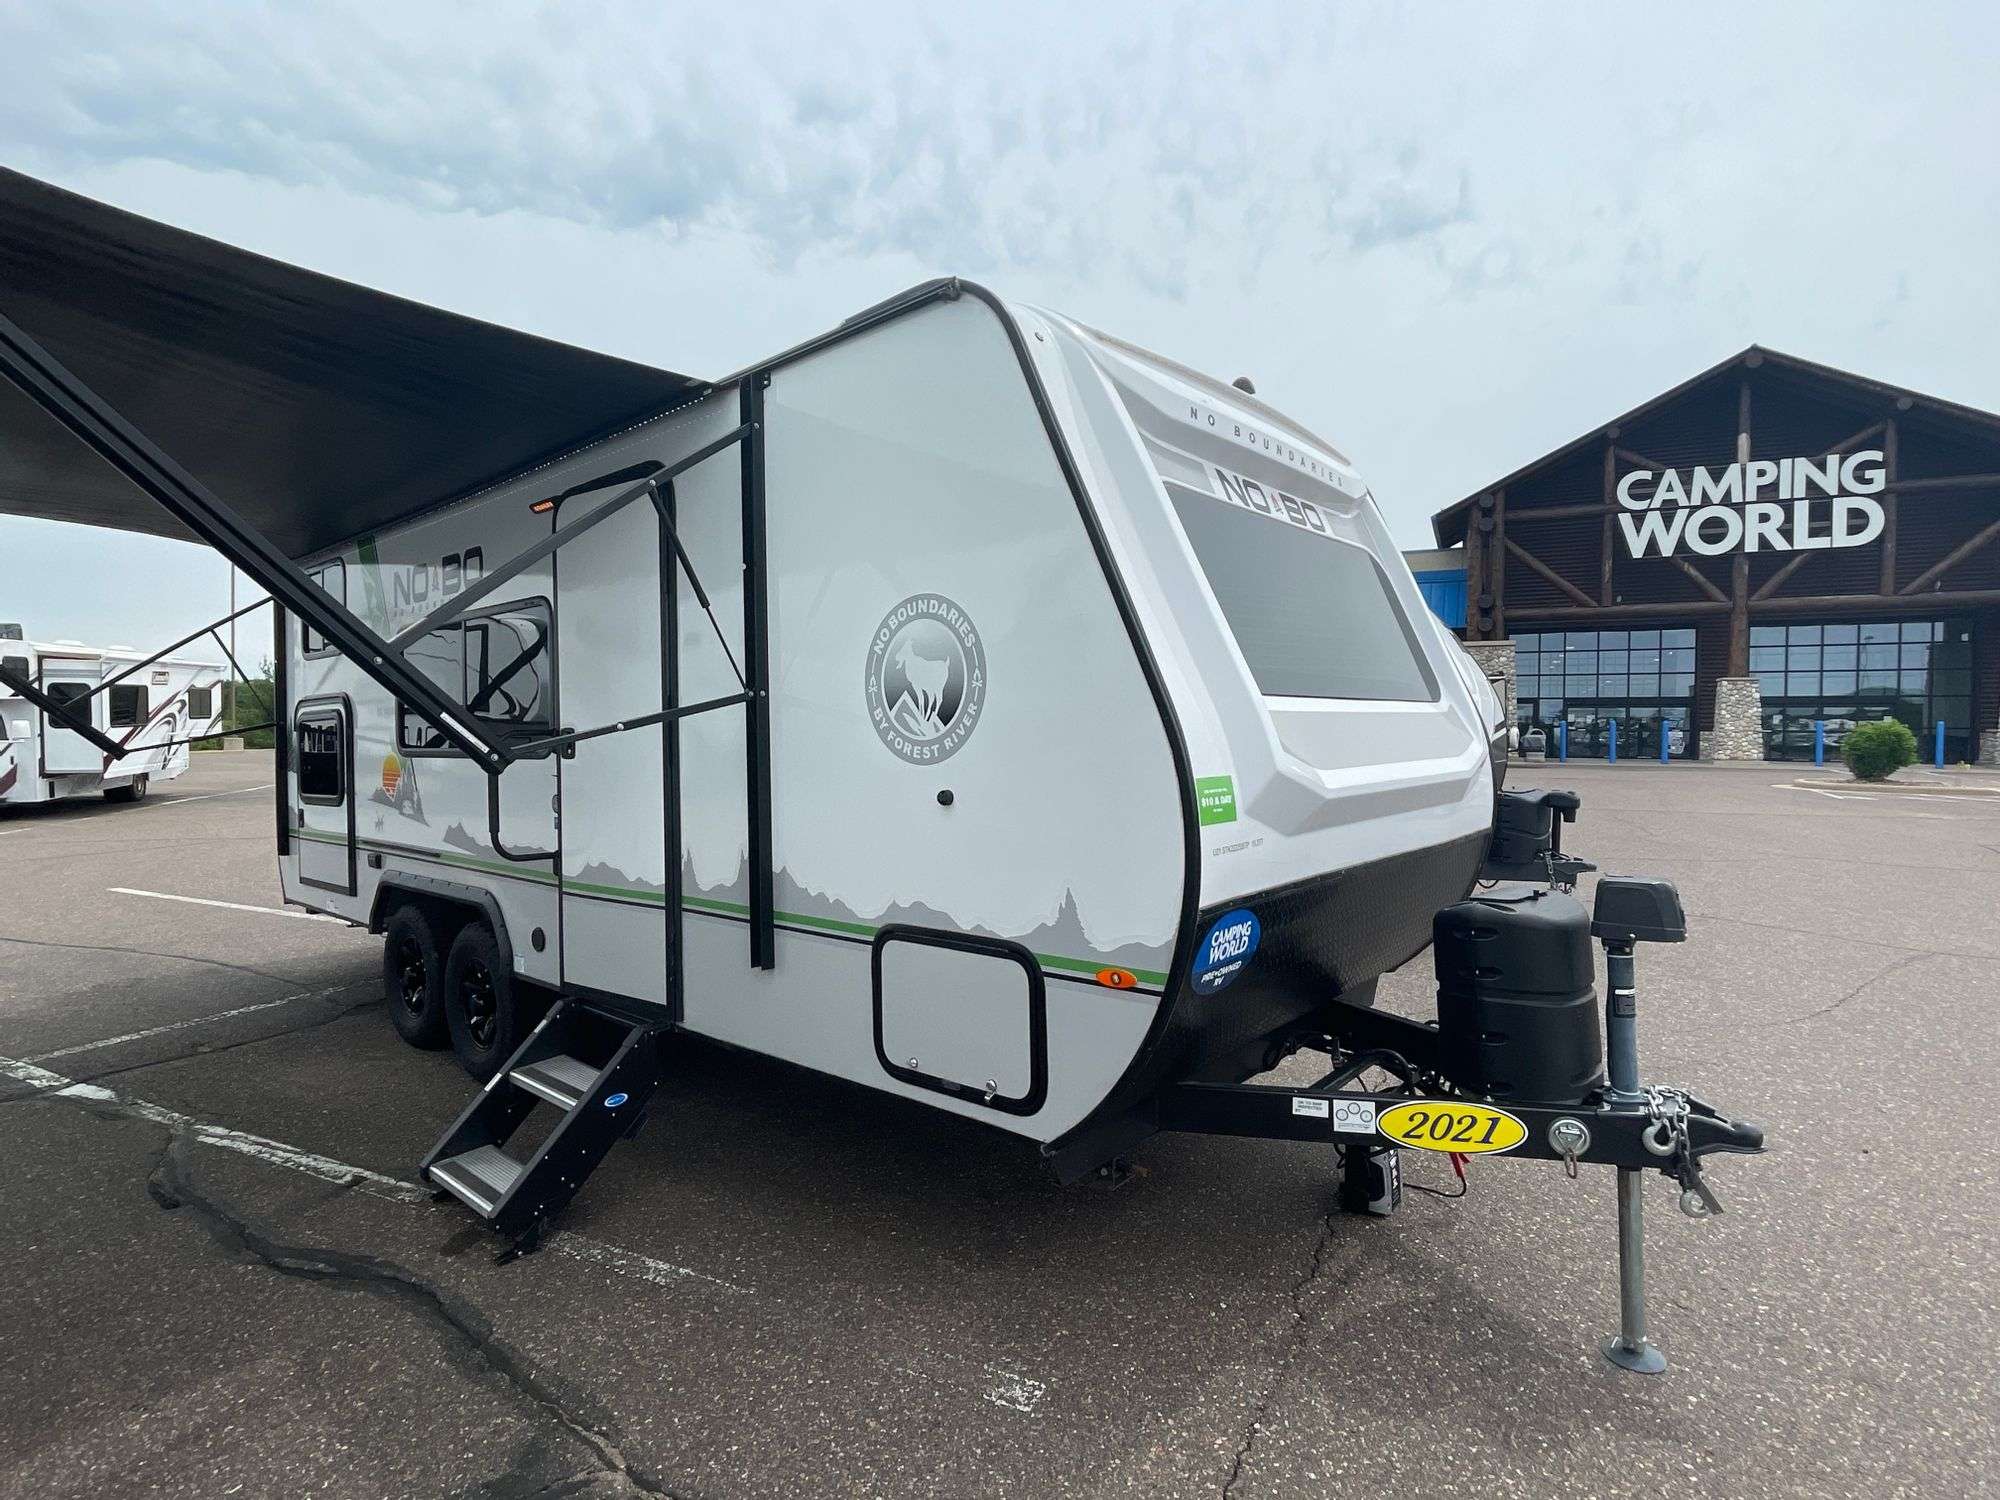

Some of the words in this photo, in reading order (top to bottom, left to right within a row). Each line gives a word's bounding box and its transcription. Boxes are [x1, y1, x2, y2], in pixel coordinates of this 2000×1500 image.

[1190, 406, 1215, 426] NO
[1234, 425, 1343, 487] BOUNDARIES
[1616, 450, 1886, 511] CAMPING
[1617, 496, 1886, 559] WORLD
[873, 627, 890, 655] NO
[888, 599, 976, 648] BOUNDARIES
[874, 708, 889, 730] BY
[887, 731, 940, 759] FOREST
[943, 702, 977, 751] RIVER
[1208, 936, 1249, 965] WORLD
[1211, 920, 1252, 947] CAMPING
[1402, 1111, 1502, 1145] 2021
